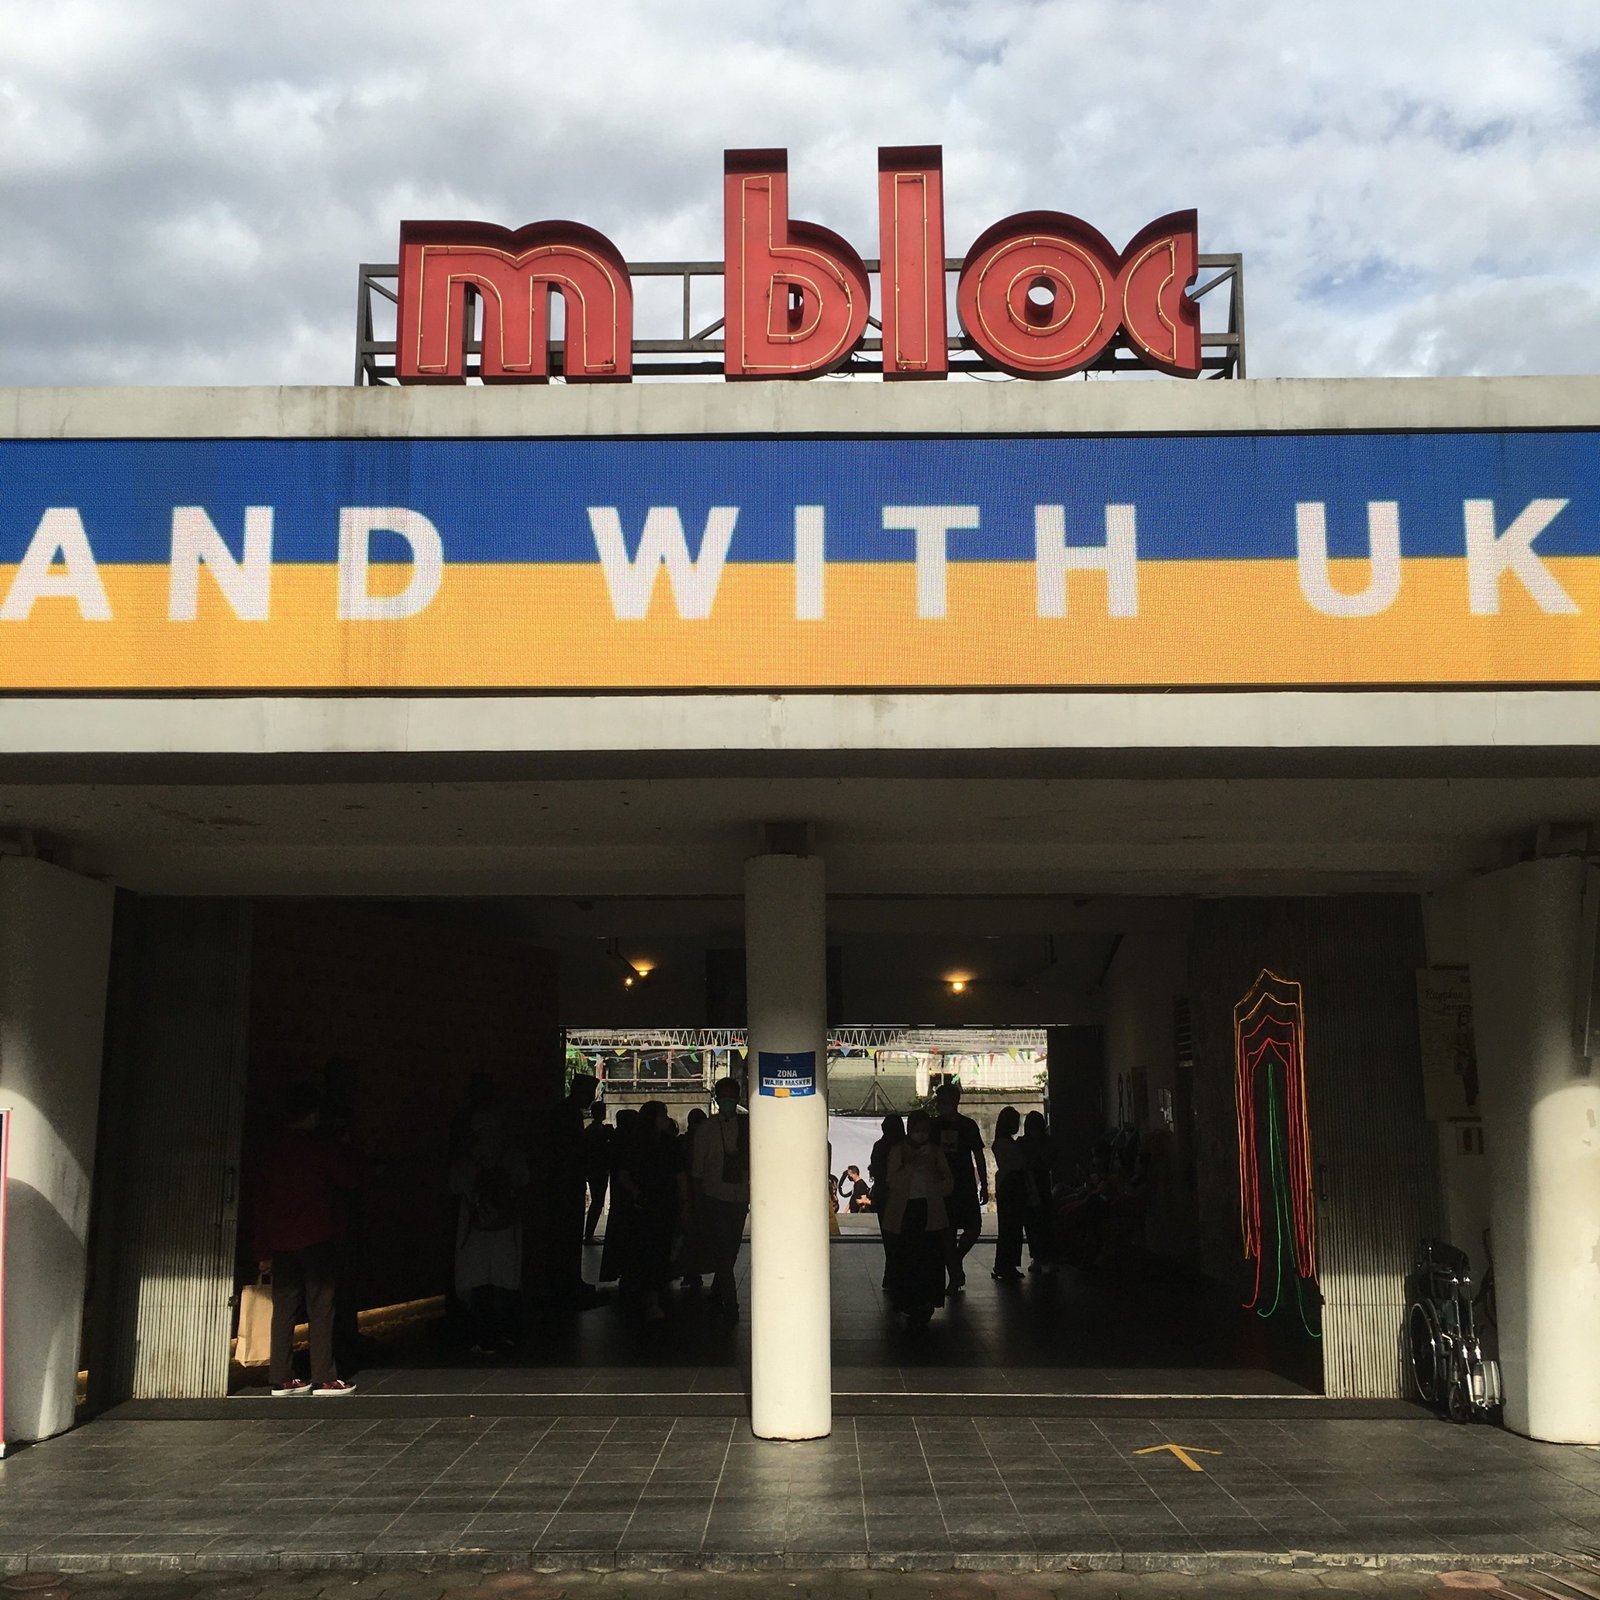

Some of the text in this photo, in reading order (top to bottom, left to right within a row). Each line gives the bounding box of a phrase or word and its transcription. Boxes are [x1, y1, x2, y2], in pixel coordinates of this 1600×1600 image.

[397, 146, 1199, 385] m bloc
[0, 499, 1582, 622] AND WITH UK
[764, 1078, 811, 1086] WAJIB MASKER
[777, 1069, 798, 1077] ZONA
